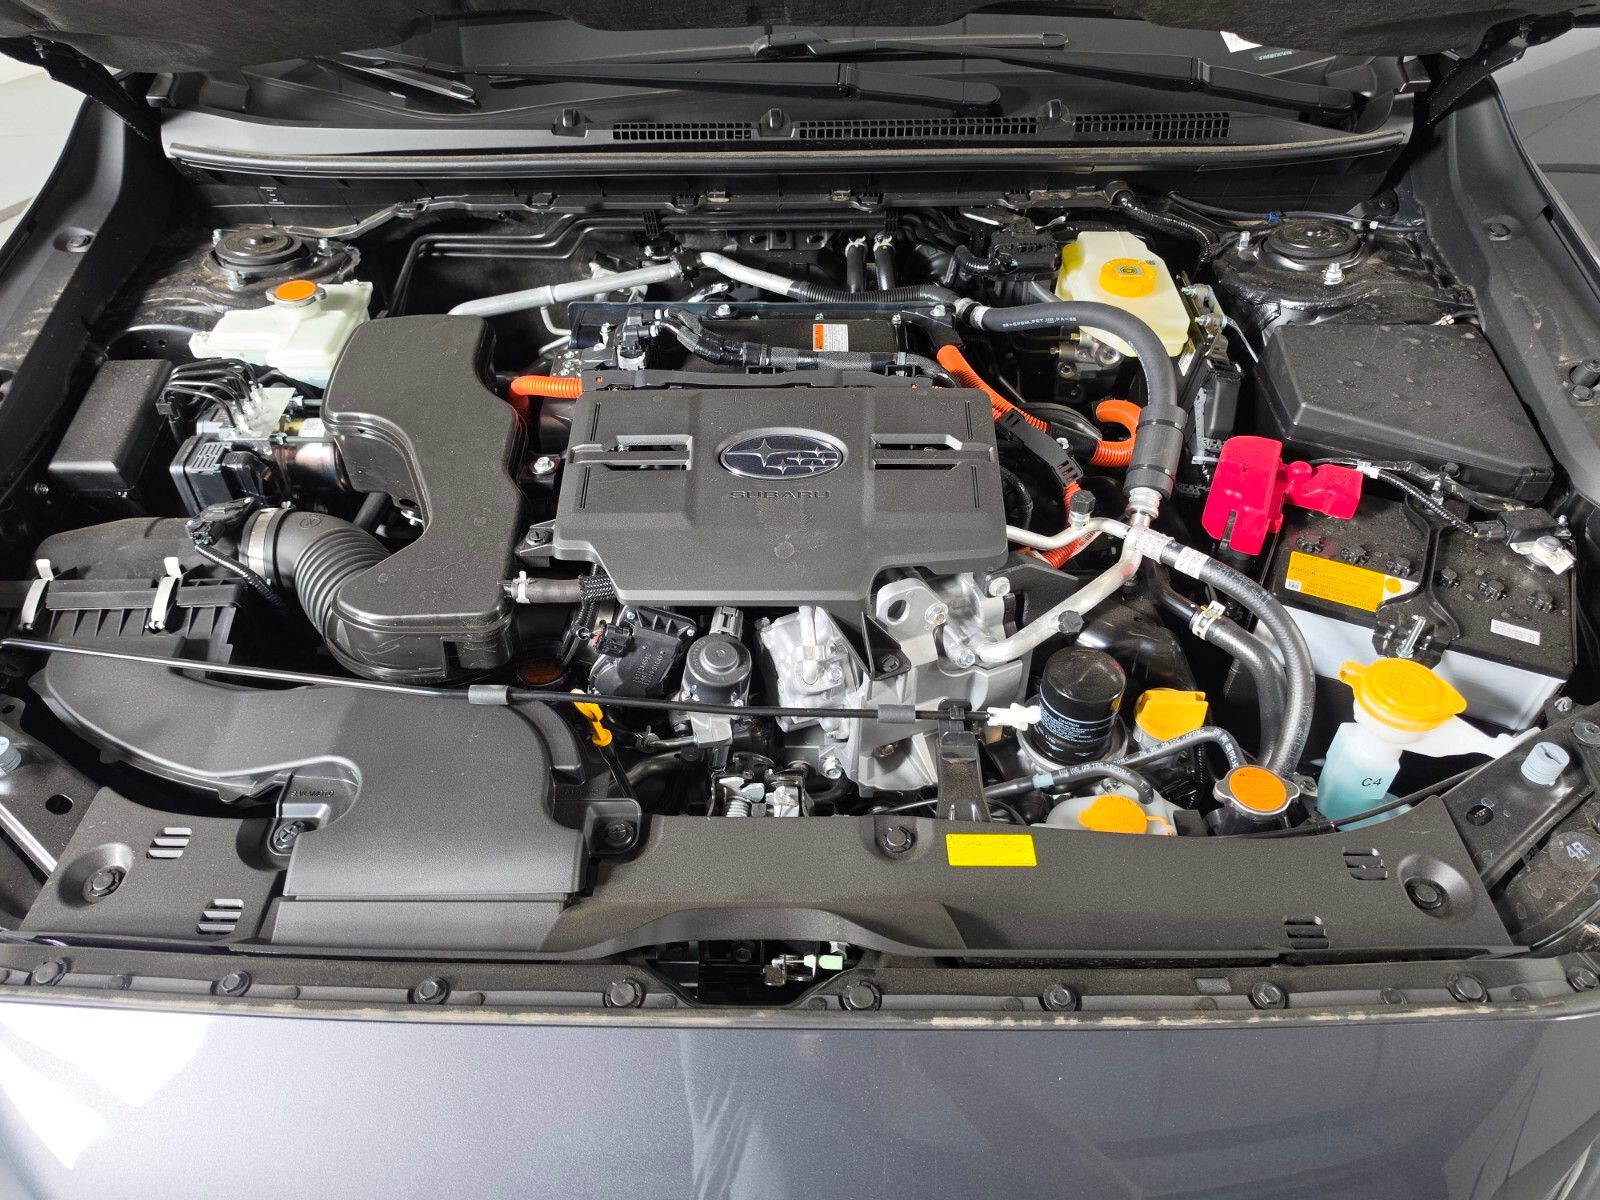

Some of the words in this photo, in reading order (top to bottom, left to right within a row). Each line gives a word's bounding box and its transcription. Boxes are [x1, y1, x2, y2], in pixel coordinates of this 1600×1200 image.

[730, 489, 830, 499] SUBARU
[1361, 777, 1382, 787] C4
[1566, 841, 1591, 860] 4R
